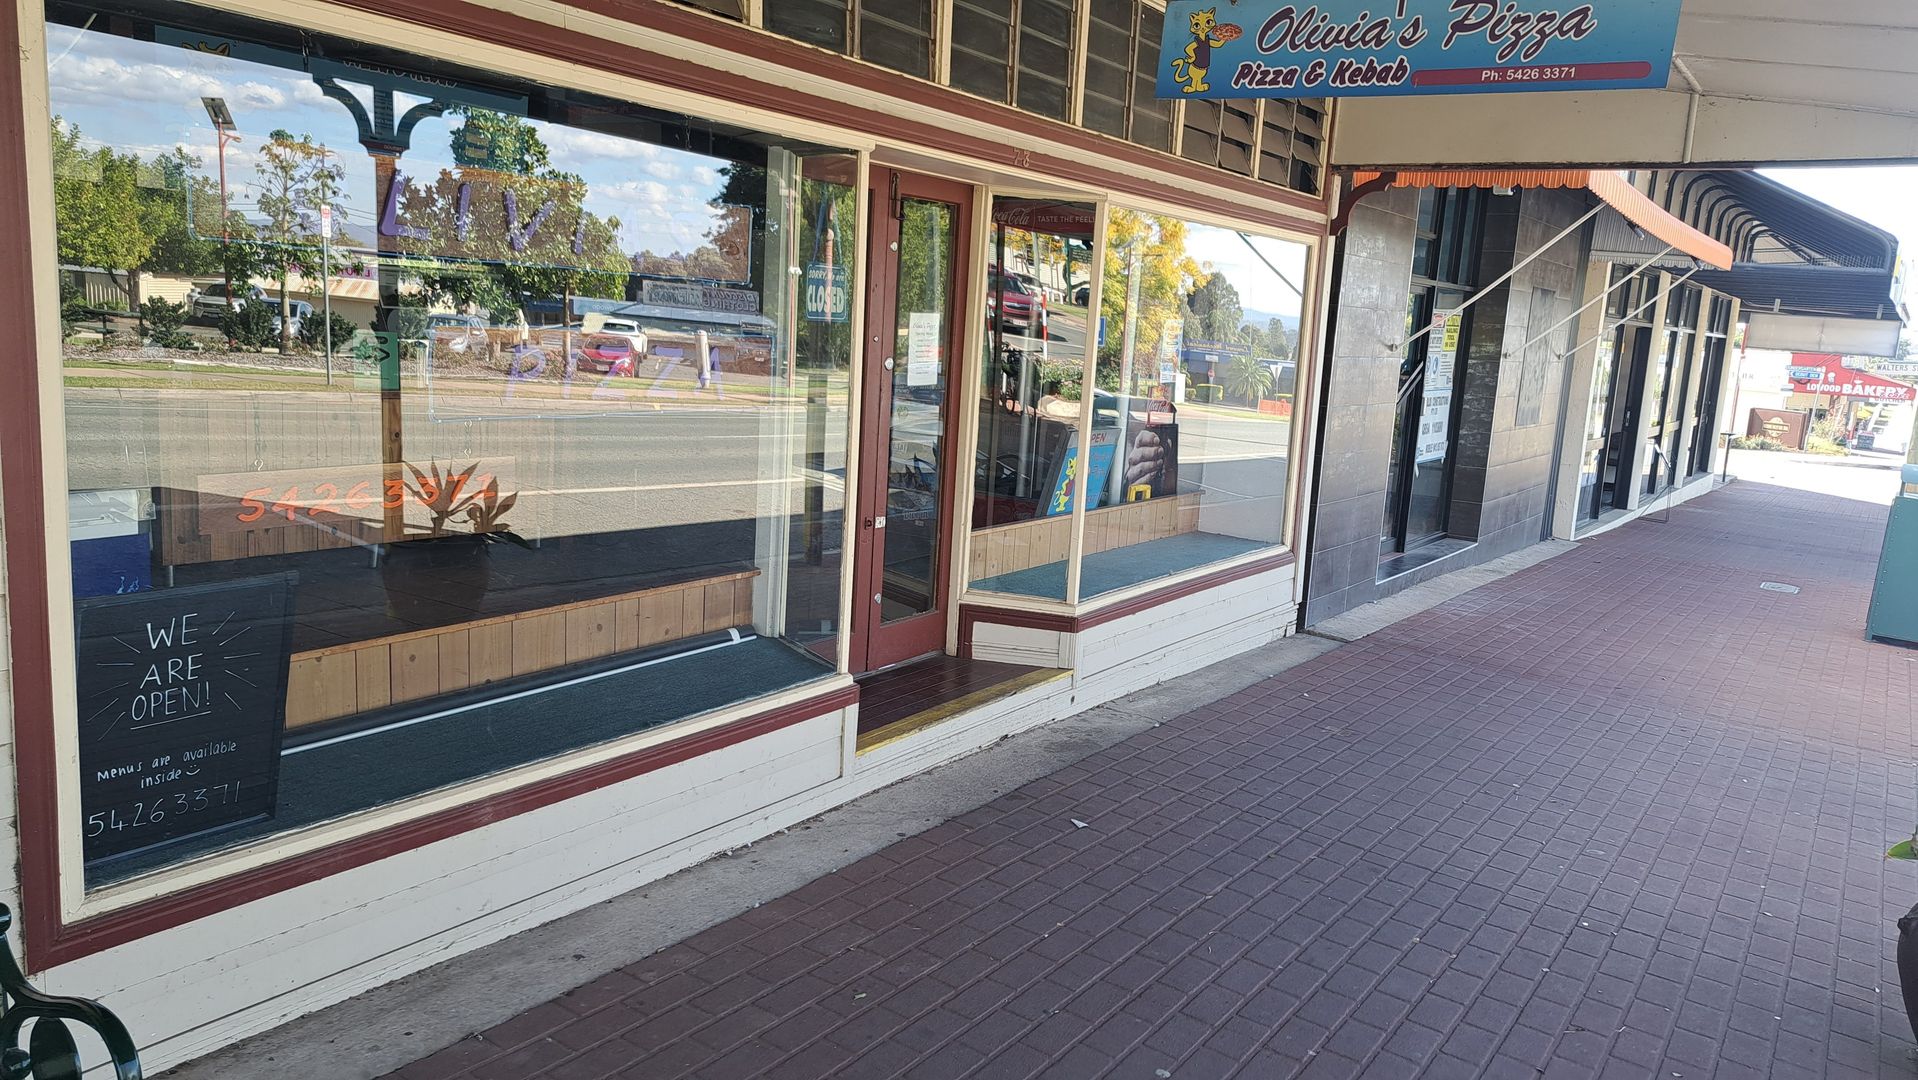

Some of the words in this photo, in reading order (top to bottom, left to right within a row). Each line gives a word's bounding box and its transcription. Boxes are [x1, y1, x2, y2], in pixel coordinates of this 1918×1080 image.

[1256, 0, 1428, 55] Olivia's
[1441, 0, 1598, 64] Pizza
[1231, 60, 1301, 90] Pizza
[1302, 58, 1327, 88] &
[1328, 55, 1411, 88] Kebab
[1481, 70, 1503, 82] Ph:
[1506, 68, 1540, 81] 5426
[1543, 66, 1576, 79] 3371
[1037, 215, 1057, 223] TASTE
[1060, 215, 1073, 223] THE
[807, 284, 845, 314] CLOSED
[1876, 363, 1909, 372] WALTERS
[1841, 383, 1909, 397] BAKERY
[1090, 432, 1107, 443] PEN
[146, 613, 199, 650] WE
[140, 653, 203, 689] ARE
[131, 681, 211, 721] OPEN!
[151, 755, 171, 769] are
[182, 740, 237, 763] available
[140, 769, 182, 789] inside
